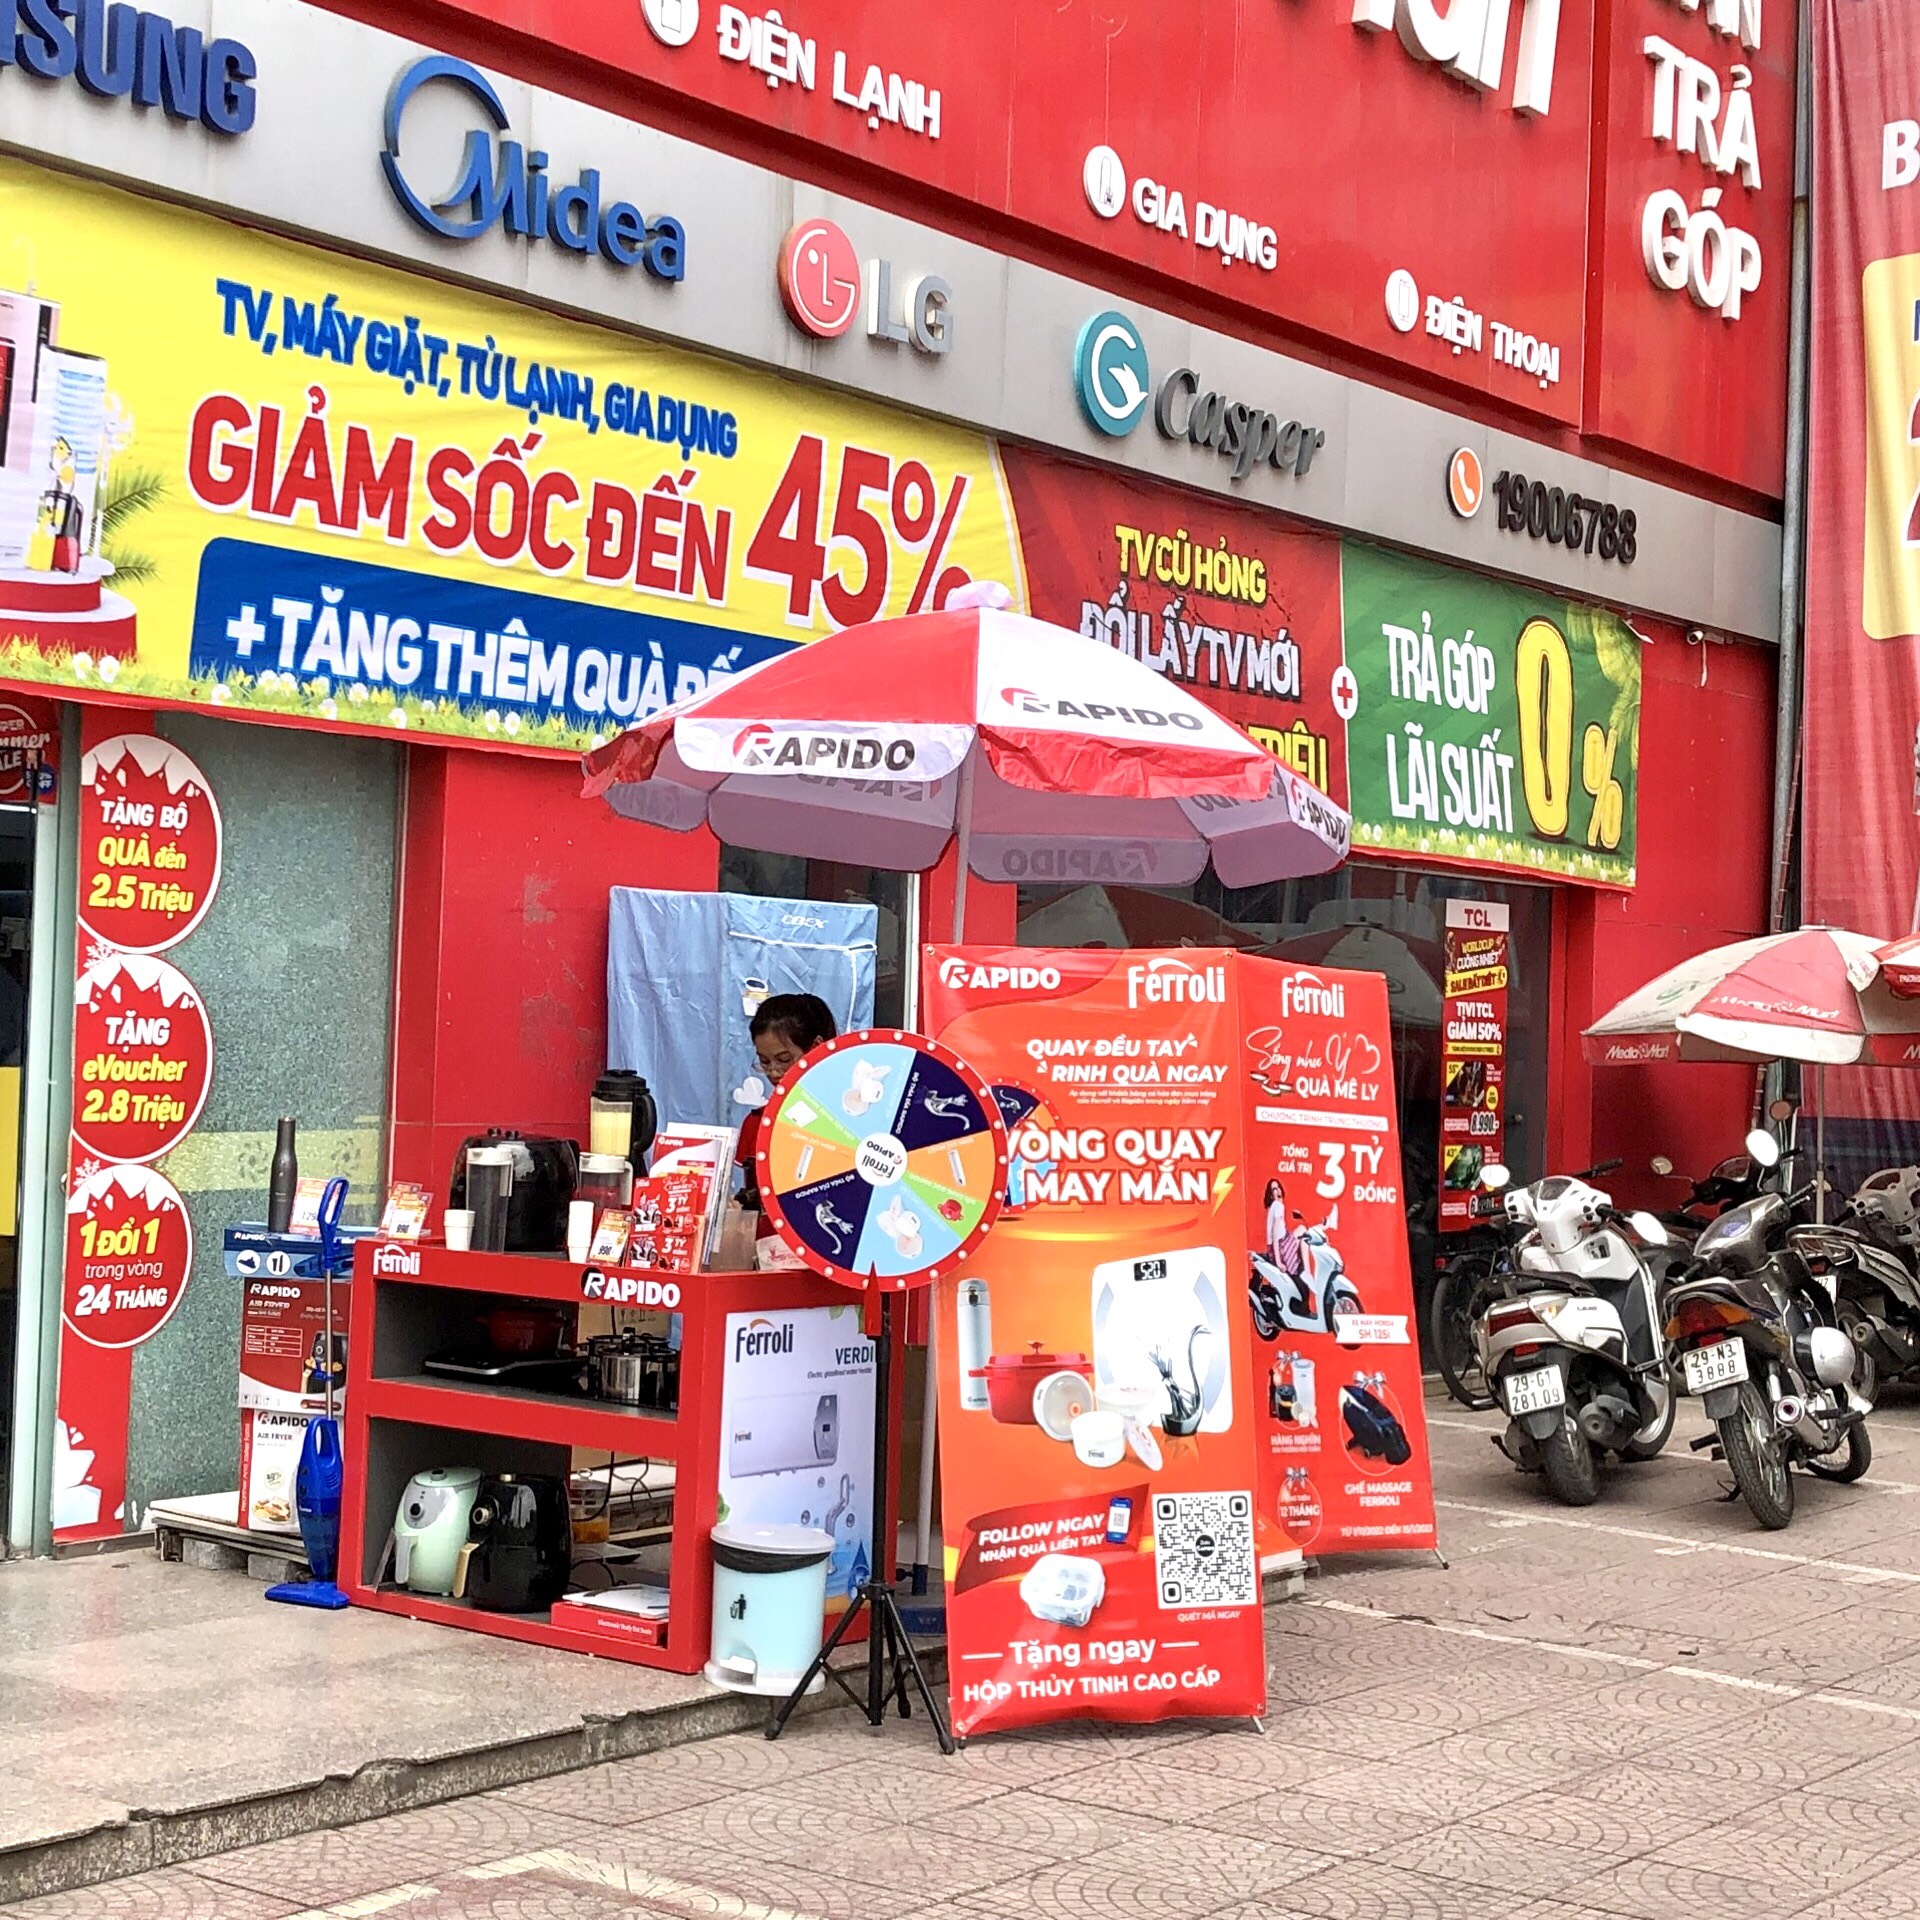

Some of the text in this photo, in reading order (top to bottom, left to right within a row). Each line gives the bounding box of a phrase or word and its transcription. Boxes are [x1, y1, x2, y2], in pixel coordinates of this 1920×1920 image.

[0, 0, 256, 134] SUNG
[717, 4, 941, 139] ĐIỆN LẠNH
[1643, 35, 1762, 190] TRẢ
[430, 130, 684, 282] Midea
[1132, 178, 1278, 271] GIA DỤNG
[1642, 187, 1762, 321] GÓP
[867, 258, 953, 354] LG
[1425, 295, 1560, 388] ĐIỆN THOẠI
[216, 278, 738, 461] TV, MÁY GIẶT, TỦ LẠNH, GIA DỤNG
[1154, 367, 1325, 480] Casper
[188, 385, 973, 629] GIẢM SỐC ĐẾN 45%
[1493, 470, 1637, 564] 19006788
[1115, 524, 1267, 604] TV CŨ HỎNG
[271, 585, 423, 685] TĂNG
[427, 618, 570, 707] THÊM
[573, 641, 666, 720] QUÀ
[1140, 596, 1204, 680] LẤY
[1202, 625, 1248, 686] TV
[1248, 628, 1300, 697] MỚI
[1382, 610, 1495, 715] TRẢ GÓP
[1001, 687, 1204, 731] RAPIDO
[733, 724, 916, 771] RAPIDO
[1386, 721, 1514, 834] LÃI SUẤT
[100, 796, 188, 836] TẶNG BỘ
[1290, 777, 1346, 847] RAPIDO
[98, 831, 187, 869] QUÀ đến
[88, 873, 195, 919] 2.5 Triệu
[1464, 908, 1491, 928] TCL
[940, 958, 1060, 989] RAPIDO
[1128, 957, 1226, 1009] Ferroli
[1281, 971, 1345, 1018] Ferroli
[1476, 1002, 1495, 1018] TCL
[105, 1009, 171, 1053] TẶNG
[1447, 1016, 1502, 1041] GIẢM 50%
[82, 1053, 188, 1082] eVoucher
[1026, 1039, 1091, 1059] QUAY
[1146, 1039, 1187, 1057] TAY
[1052, 1061, 1228, 1086] RINH QUÀ NGAY
[1296, 1076, 1379, 1101] QUÀ MÊ LY
[81, 1088, 186, 1131] 2.8 Triệu
[862, 1155, 896, 1178] Ferroli
[1114, 1129, 1222, 1164] QUAY
[1278, 1158, 1313, 1175] GIÁ TRỊ
[1026, 1159, 1208, 1204] MAY MẮN
[1315, 1135, 1384, 1199] 3 TỶ
[1353, 1179, 1397, 1204] ĐỒNG
[79, 1216, 160, 1258] 1 ĐỔI 1
[85, 1258, 163, 1281] trong vòng
[373, 1244, 420, 1276] Ferroli
[75, 1283, 168, 1317] 24 THÁNG
[250, 1283, 301, 1299] RAPIDO
[581, 1267, 681, 1309] RAPIDO
[736, 1318, 794, 1363] Ferroli
[835, 1345, 874, 1366] VERDI
[1691, 1343, 1737, 1369] 29-N3
[1513, 1370, 1552, 1394] 29-G1
[1696, 1360, 1736, 1385] 3888
[258, 1411, 310, 1428] RAPIDO
[1512, 1388, 1561, 1413] 281.09
[1360, 1495, 1401, 1507] FERROLI
[1366, 1481, 1413, 1494] MASSAGE
[979, 1513, 1106, 1546] FOLLOW NGAY
[1288, 1502, 1320, 1517] THÁNG
[979, 1545, 1016, 1564] NHẬN
[1019, 1540, 1048, 1557] QUÀ
[1081, 1533, 1106, 1546] TAY
[1216, 1610, 1241, 1621] NGAY
[1009, 1639, 1156, 1669] Tặng ngay
[964, 1664, 1221, 1704] HỘP THỦY TINH CAO CẤP
